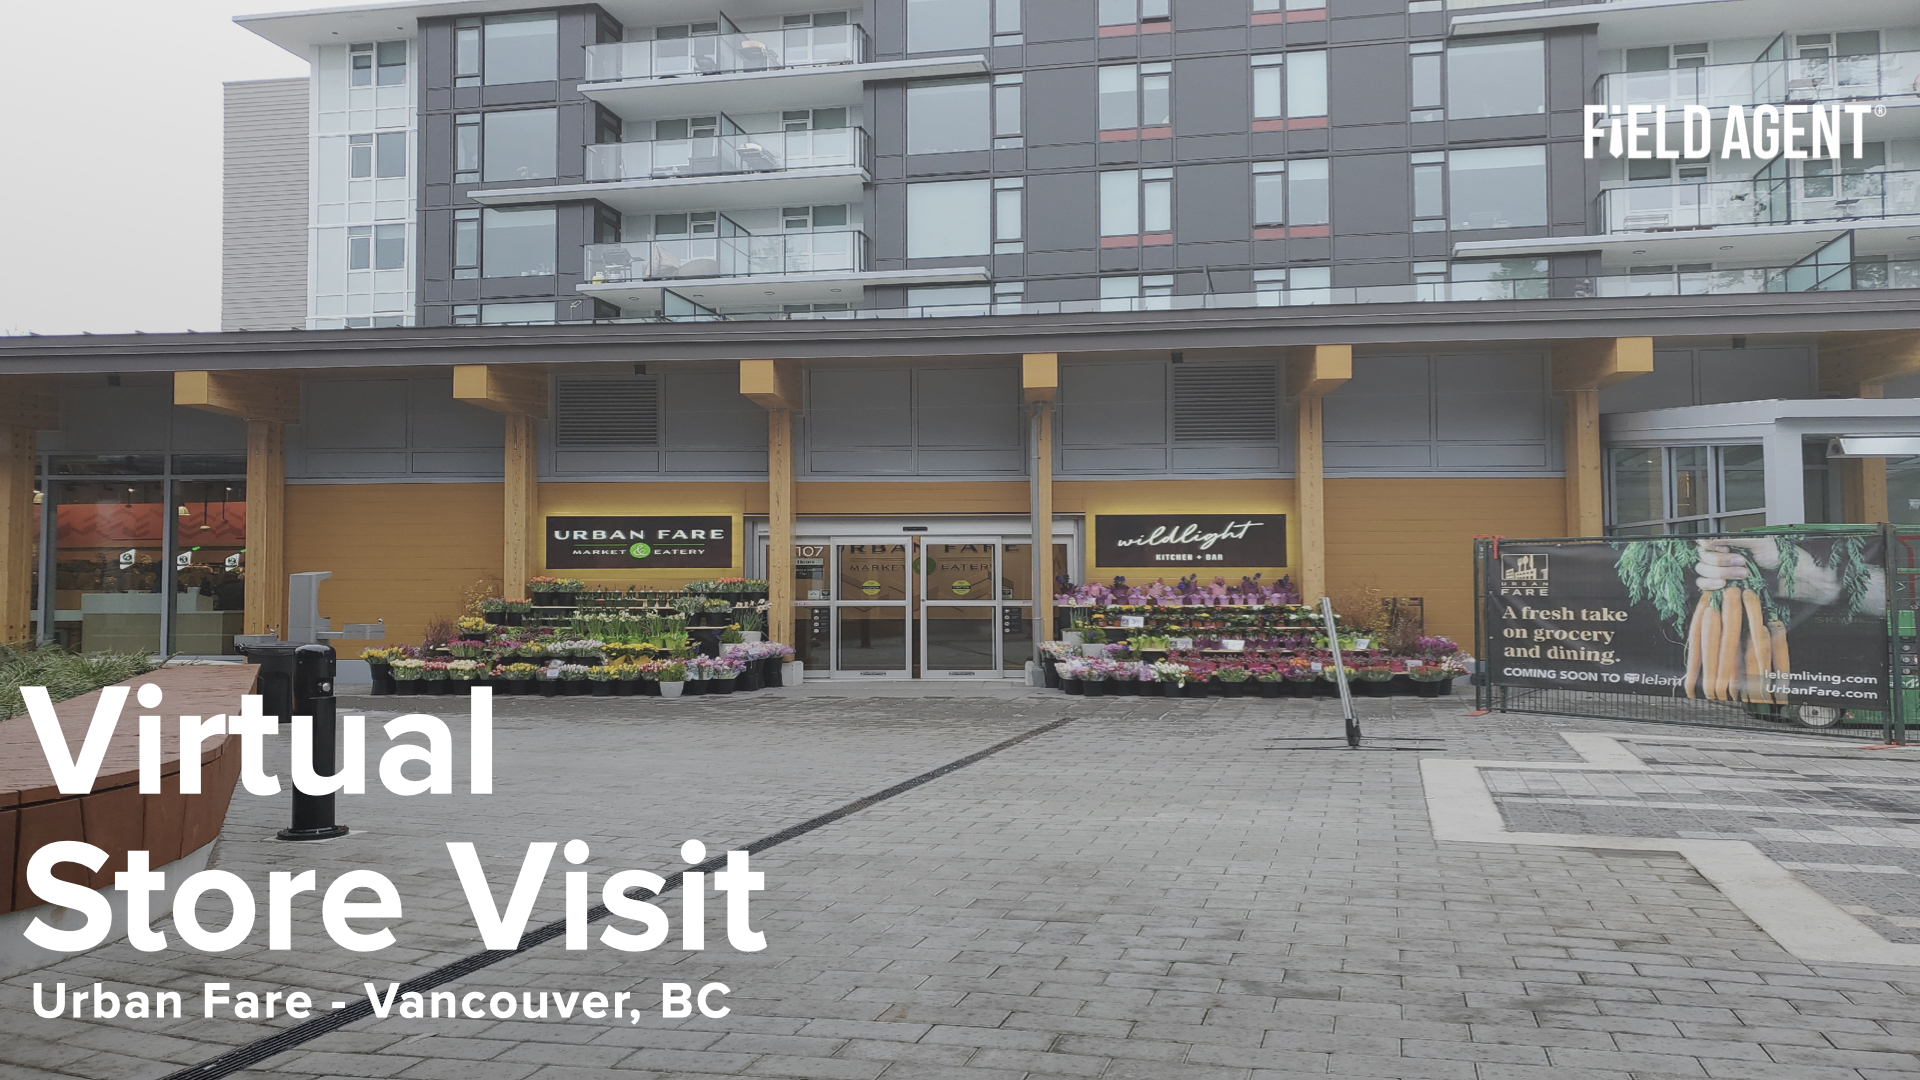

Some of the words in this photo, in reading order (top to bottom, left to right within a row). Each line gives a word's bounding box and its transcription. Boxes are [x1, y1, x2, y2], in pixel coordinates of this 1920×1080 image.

[553, 529, 645, 541] URBAN
[657, 529, 725, 540] FARE
[1117, 520, 1265, 550] wildlight
[632, 544, 647, 556] &
[796, 546, 824, 557] 107
[1155, 553, 1193, 561] KITCHEN
[1205, 553, 1224, 561] BAR
[940, 563, 993, 571] EATER
[1501, 588, 1549, 596] FARE
[1502, 605, 1518, 620] A
[1521, 606, 1576, 621] fresh
[1580, 607, 1629, 622] take
[1503, 627, 1529, 639] on
[1533, 628, 1615, 645] grocery
[1503, 645, 1541, 659] and
[1546, 645, 1621, 666] dining.
[1503, 667, 1557, 680] COMING
[1559, 670, 1599, 682] SOON
[1600, 672, 1621, 683] TO
[1764, 669, 1878, 685] lelemliving.com
[1765, 684, 1878, 700] UrbanFare.com
